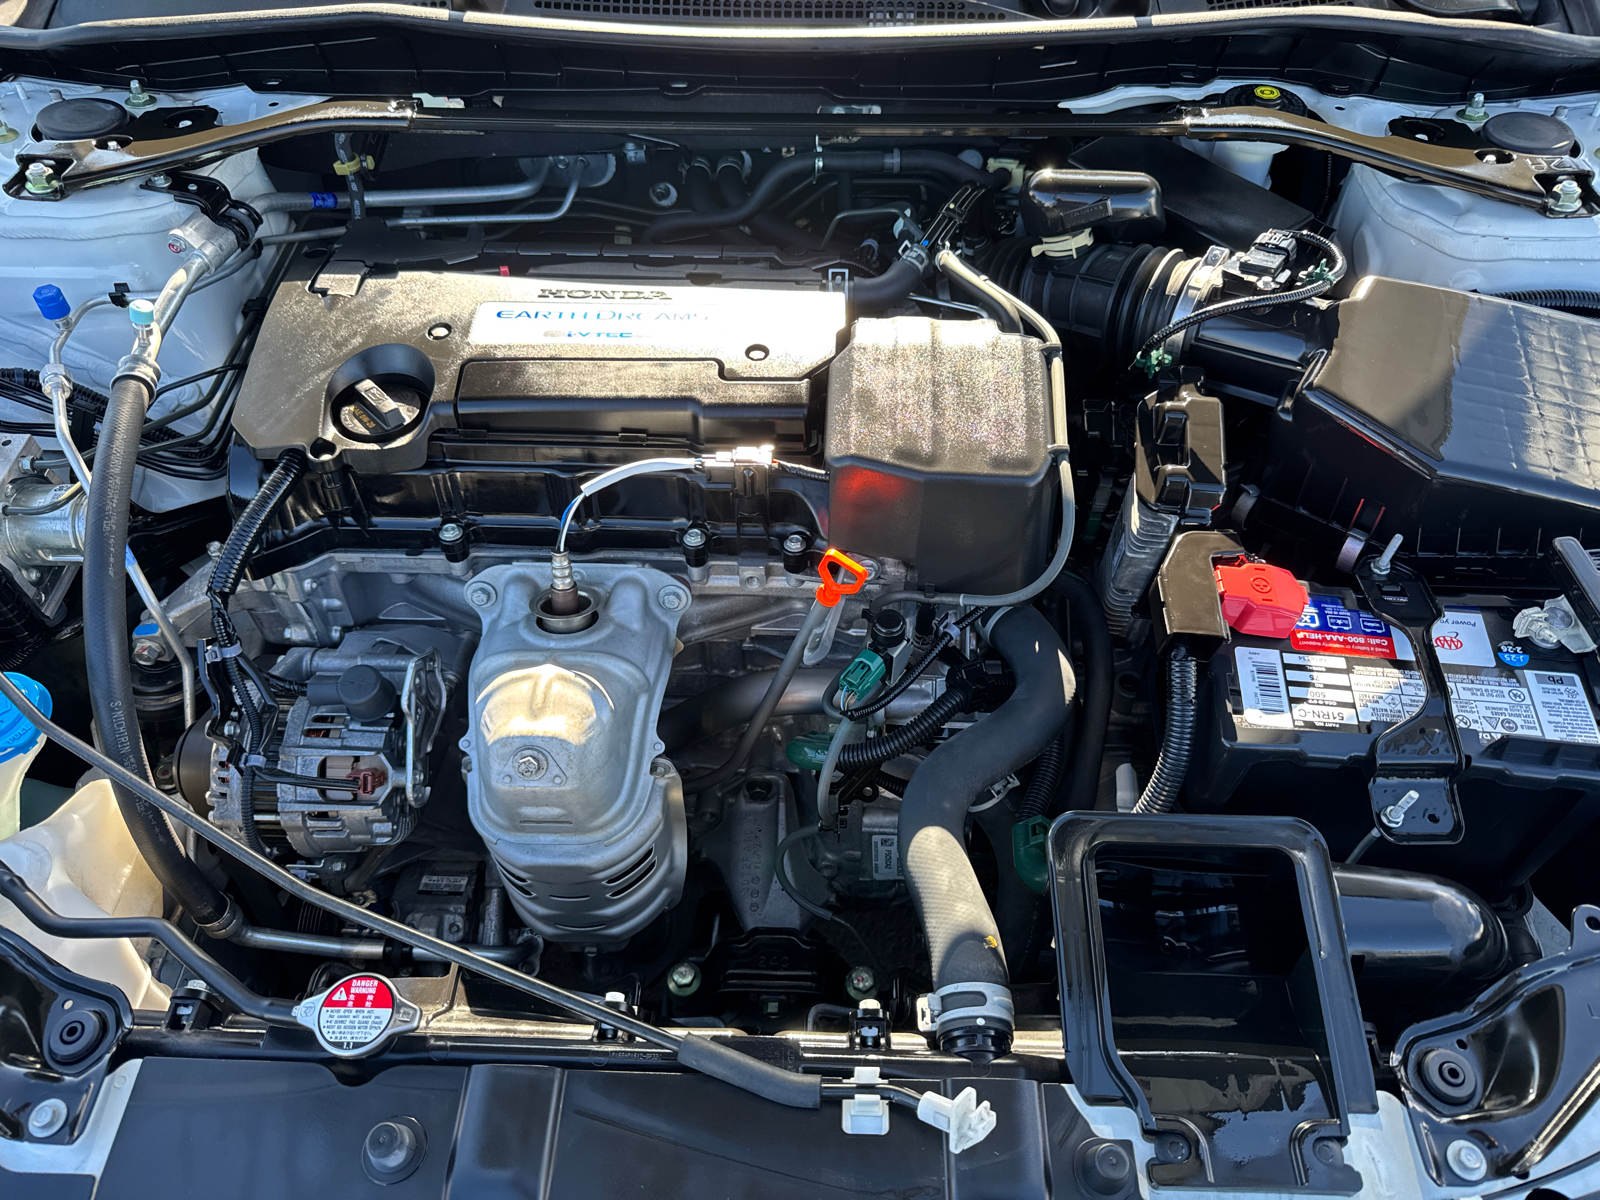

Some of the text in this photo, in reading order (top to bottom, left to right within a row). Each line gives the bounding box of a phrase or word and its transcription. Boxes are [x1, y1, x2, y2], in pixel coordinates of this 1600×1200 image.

[537, 288, 673, 301] HONDA
[496, 310, 589, 321] EARTH
[1297, 632, 1364, 643] 800-AAA-HELP
[1437, 636, 1461, 650] AAA
[1548, 676, 1564, 684] Pb
[1298, 709, 1344, 721] 51RN-C
[7, 725, 32, 745] PULL
